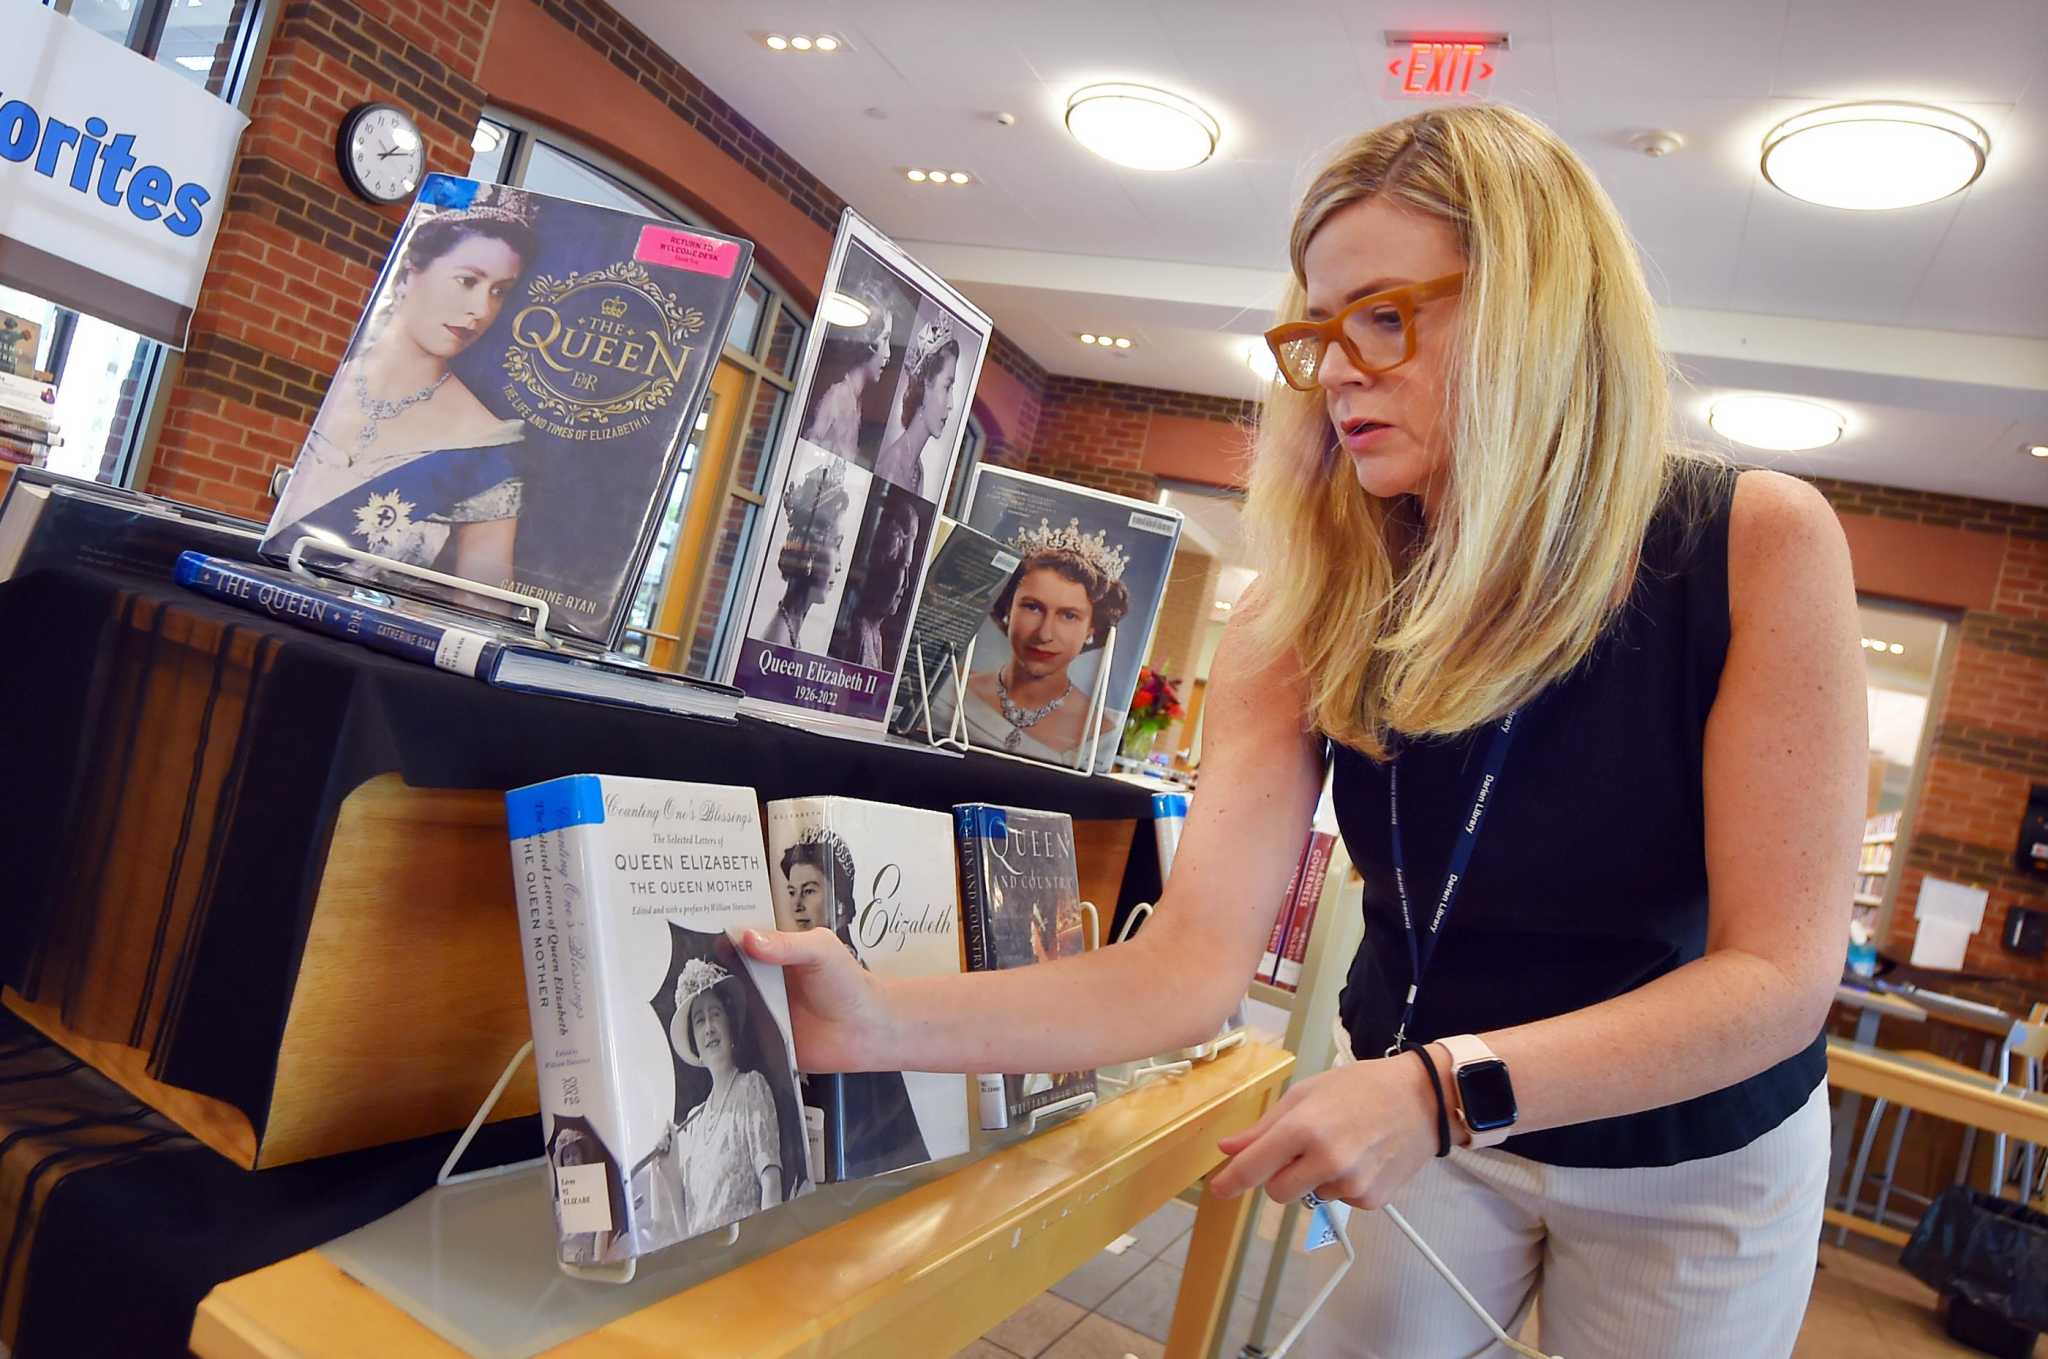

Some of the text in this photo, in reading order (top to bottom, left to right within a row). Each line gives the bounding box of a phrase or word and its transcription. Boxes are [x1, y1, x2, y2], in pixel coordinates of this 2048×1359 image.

[1402, 43, 1484, 96] EXIT
[0, 92, 211, 237] orites
[660, 243, 698, 257] WELCOME
[670, 236, 714, 252] RETURN TO
[511, 305, 695, 383] QUEEN
[589, 316, 625, 336] THE
[503, 384, 650, 441] THE LIFE AND TIMES OF ELIZABETH II
[216, 570, 329, 622] THE QUEEN
[500, 577, 597, 615] CATHERINE RYAN
[758, 649, 878, 695] Queen Elizabeth II
[794, 684, 838, 706] 1926-2022
[1501, 710, 1517, 734] brary
[605, 793, 753, 832] Counting One's Blessings
[1464, 773, 1495, 834] Darien Library
[653, 832, 725, 848] The Selected Letters of
[988, 815, 1071, 876] QUEEN
[614, 854, 760, 872] QUEEN ELIZABETH
[993, 874, 1018, 889] AND
[543, 875, 554, 916] Letters
[629, 880, 753, 894] THE QUEEN MOTHER
[966, 873, 977, 901] AND
[1395, 867, 1412, 929] Darien Library
[1429, 872, 1459, 934] Darien Library
[546, 918, 558, 931] of
[652, 904, 665, 915] and
[859, 863, 952, 952] Elizabeth
[525, 871, 541, 930] QUEEN
[533, 937, 549, 1008] MOTHER
[547, 934, 559, 973] Queen
[968, 901, 983, 970] COUNTRY
[553, 976, 569, 1037] Elizabeth
